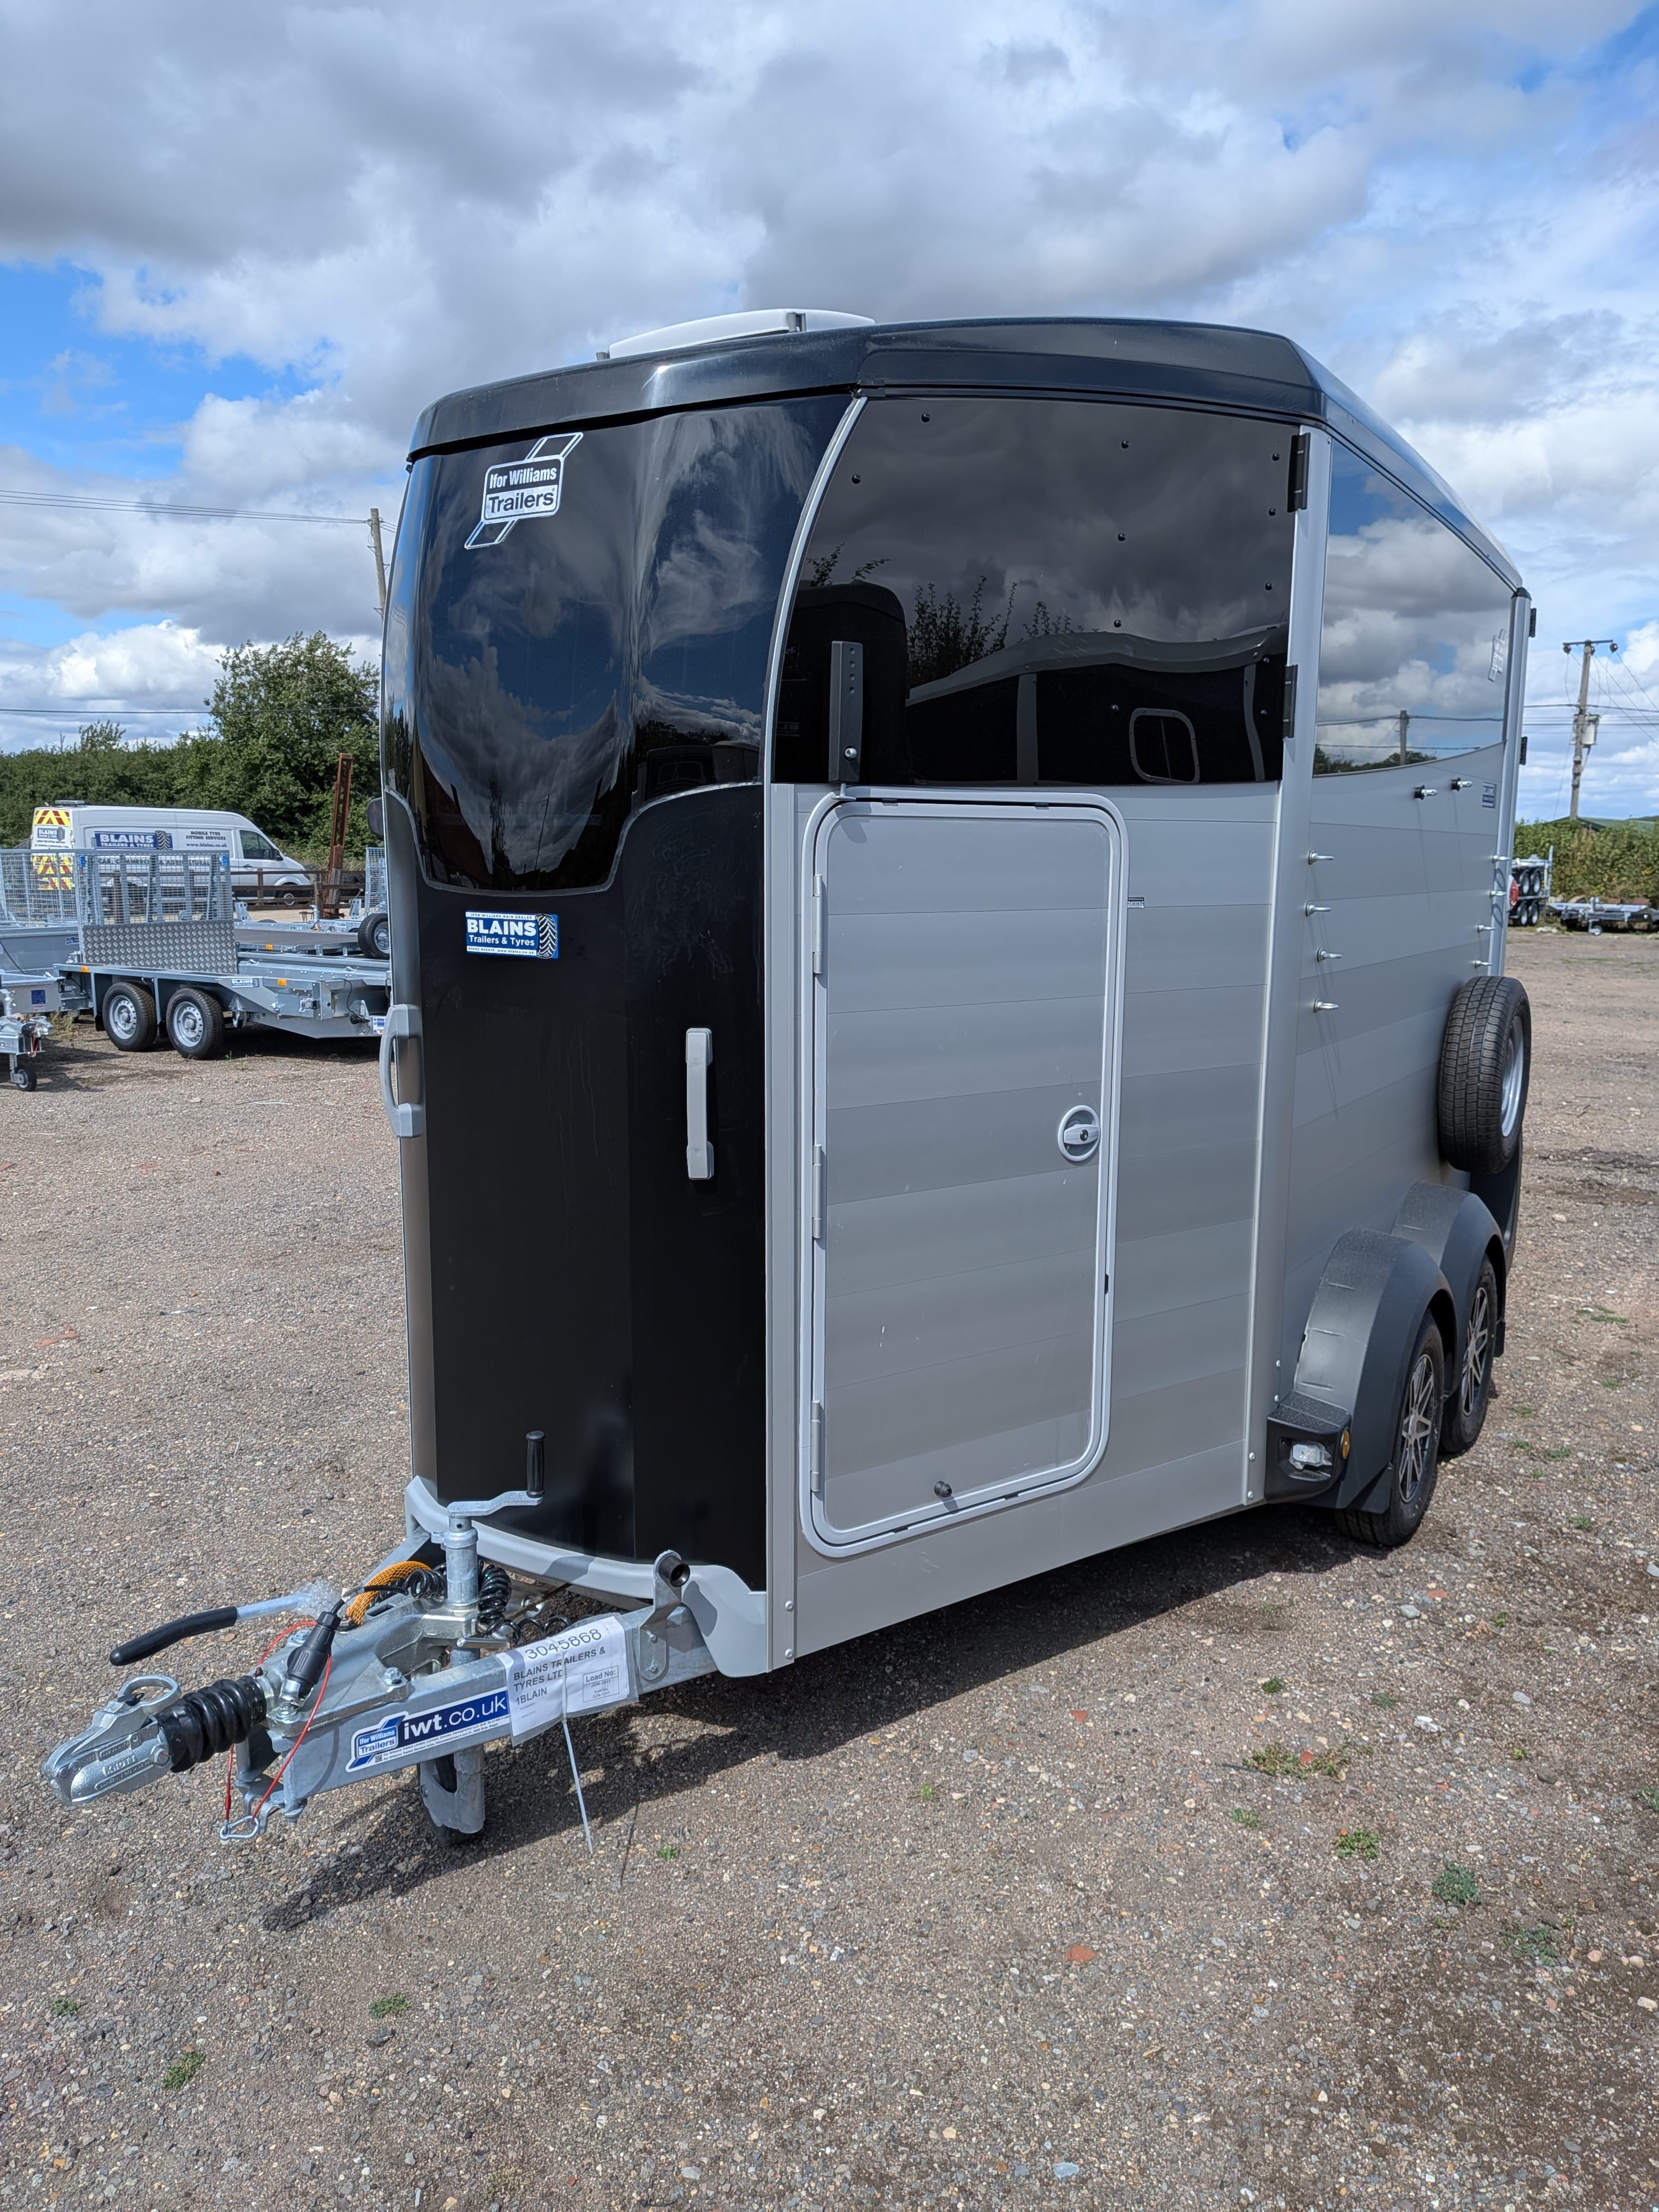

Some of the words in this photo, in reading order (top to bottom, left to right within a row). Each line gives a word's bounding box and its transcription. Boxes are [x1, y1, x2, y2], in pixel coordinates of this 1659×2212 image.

[489, 473, 508, 489] Ifor
[509, 467, 557, 486] Williams
[488, 492, 554, 513] Trailers
[100, 834, 154, 843] BLAINS
[467, 919, 536, 936] BLAINS
[469, 935, 499, 944] Trailers
[510, 937, 535, 947] Tyres
[525, 1629, 602, 1660] 3045868
[514, 1663, 548, 1681] BLAINS
[551, 1650, 597, 1669] TRAILERS
[599, 1646, 606, 1655] &
[514, 1676, 545, 1692] TYRES
[586, 1672, 603, 1682] Load
[516, 1687, 547, 1705] 1BLAIN
[404, 1695, 507, 1740] iwt.co.uk
[359, 1737, 370, 1746] Ifor
[370, 1730, 395, 1742] Williams
[359, 1739, 395, 1754] Trailers
